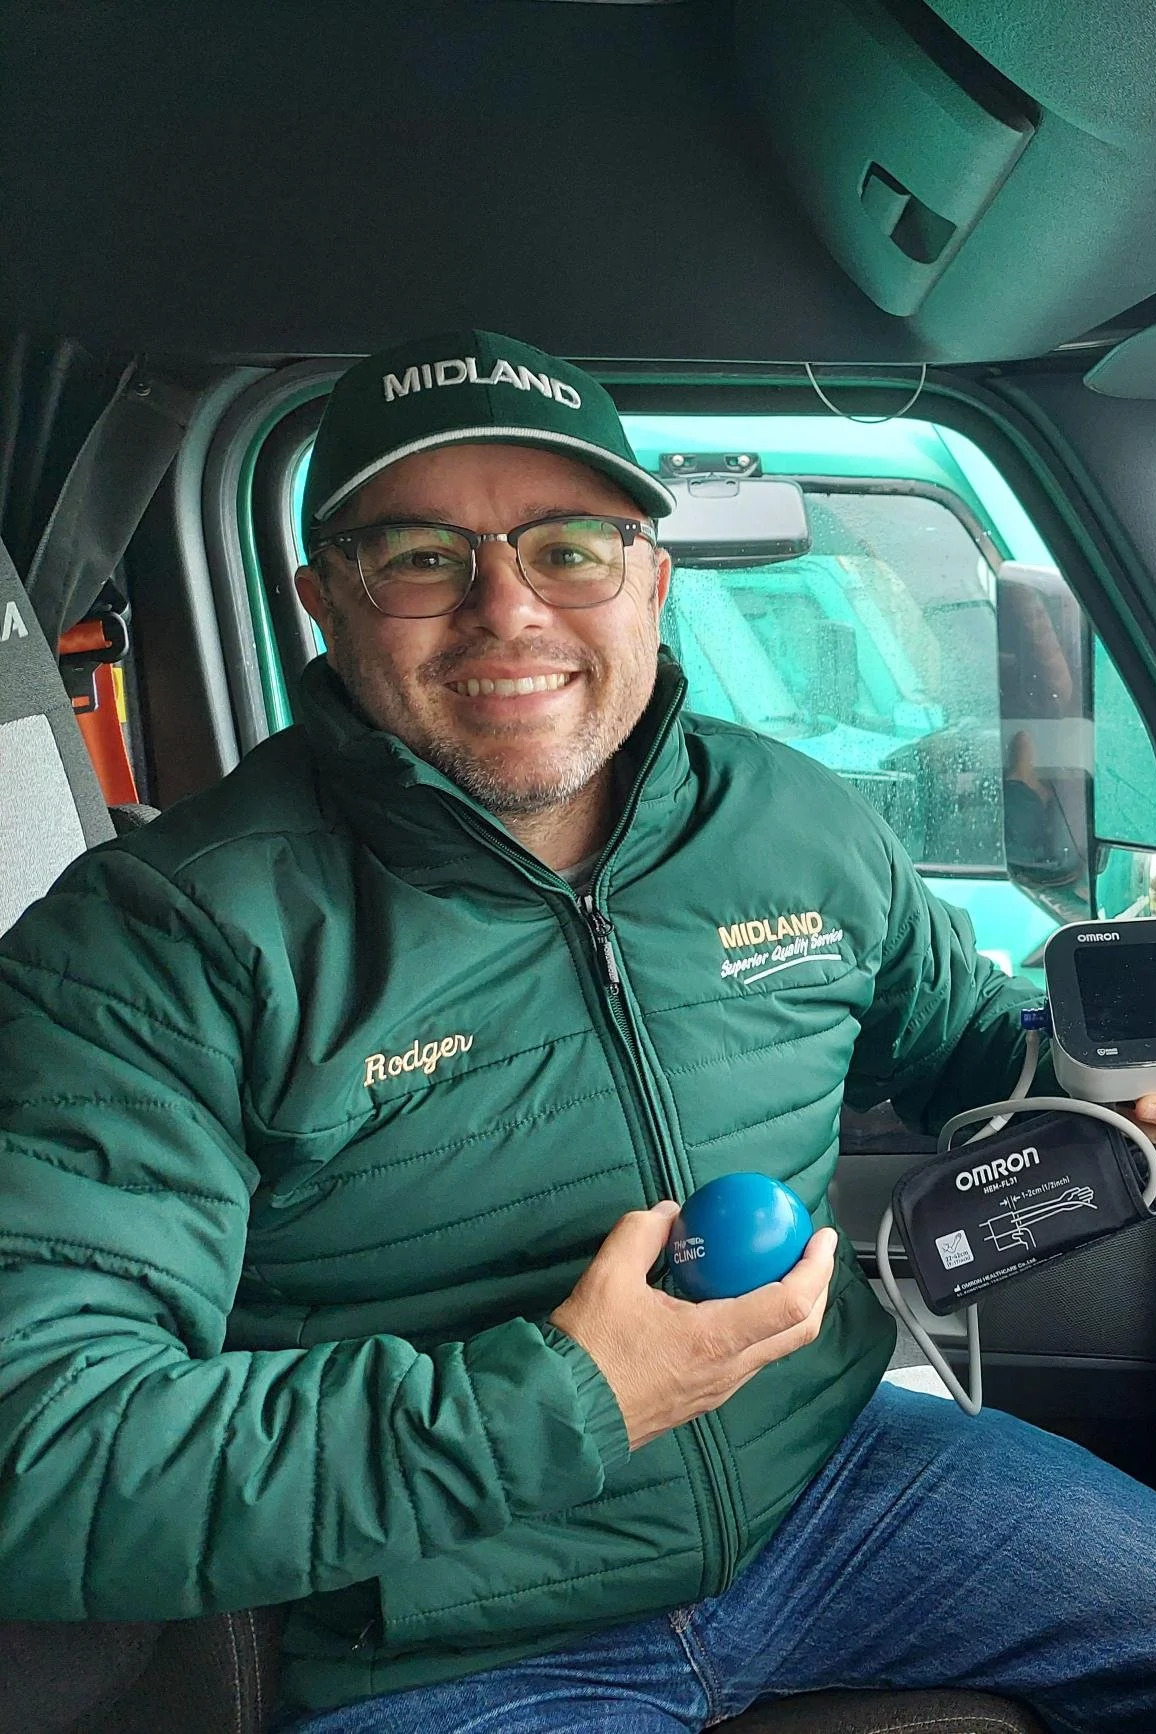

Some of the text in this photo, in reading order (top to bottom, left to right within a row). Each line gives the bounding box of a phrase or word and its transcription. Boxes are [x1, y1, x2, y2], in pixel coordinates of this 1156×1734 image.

[382, 357, 582, 410] MIDLAND
[718, 911, 823, 949] MIDLAND
[1077, 932, 1120, 943] OMRON
[720, 928, 843, 979] Superior Quality Service
[363, 1034, 474, 1088] Rodger
[955, 1146, 1040, 1192] OMRON
[983, 1176, 1018, 1195] HEM-FL31
[674, 1246, 706, 1264] CLINIC
[961, 1278, 983, 1291] OMRON
[982, 1265, 1018, 1282] HEALTHCARE
